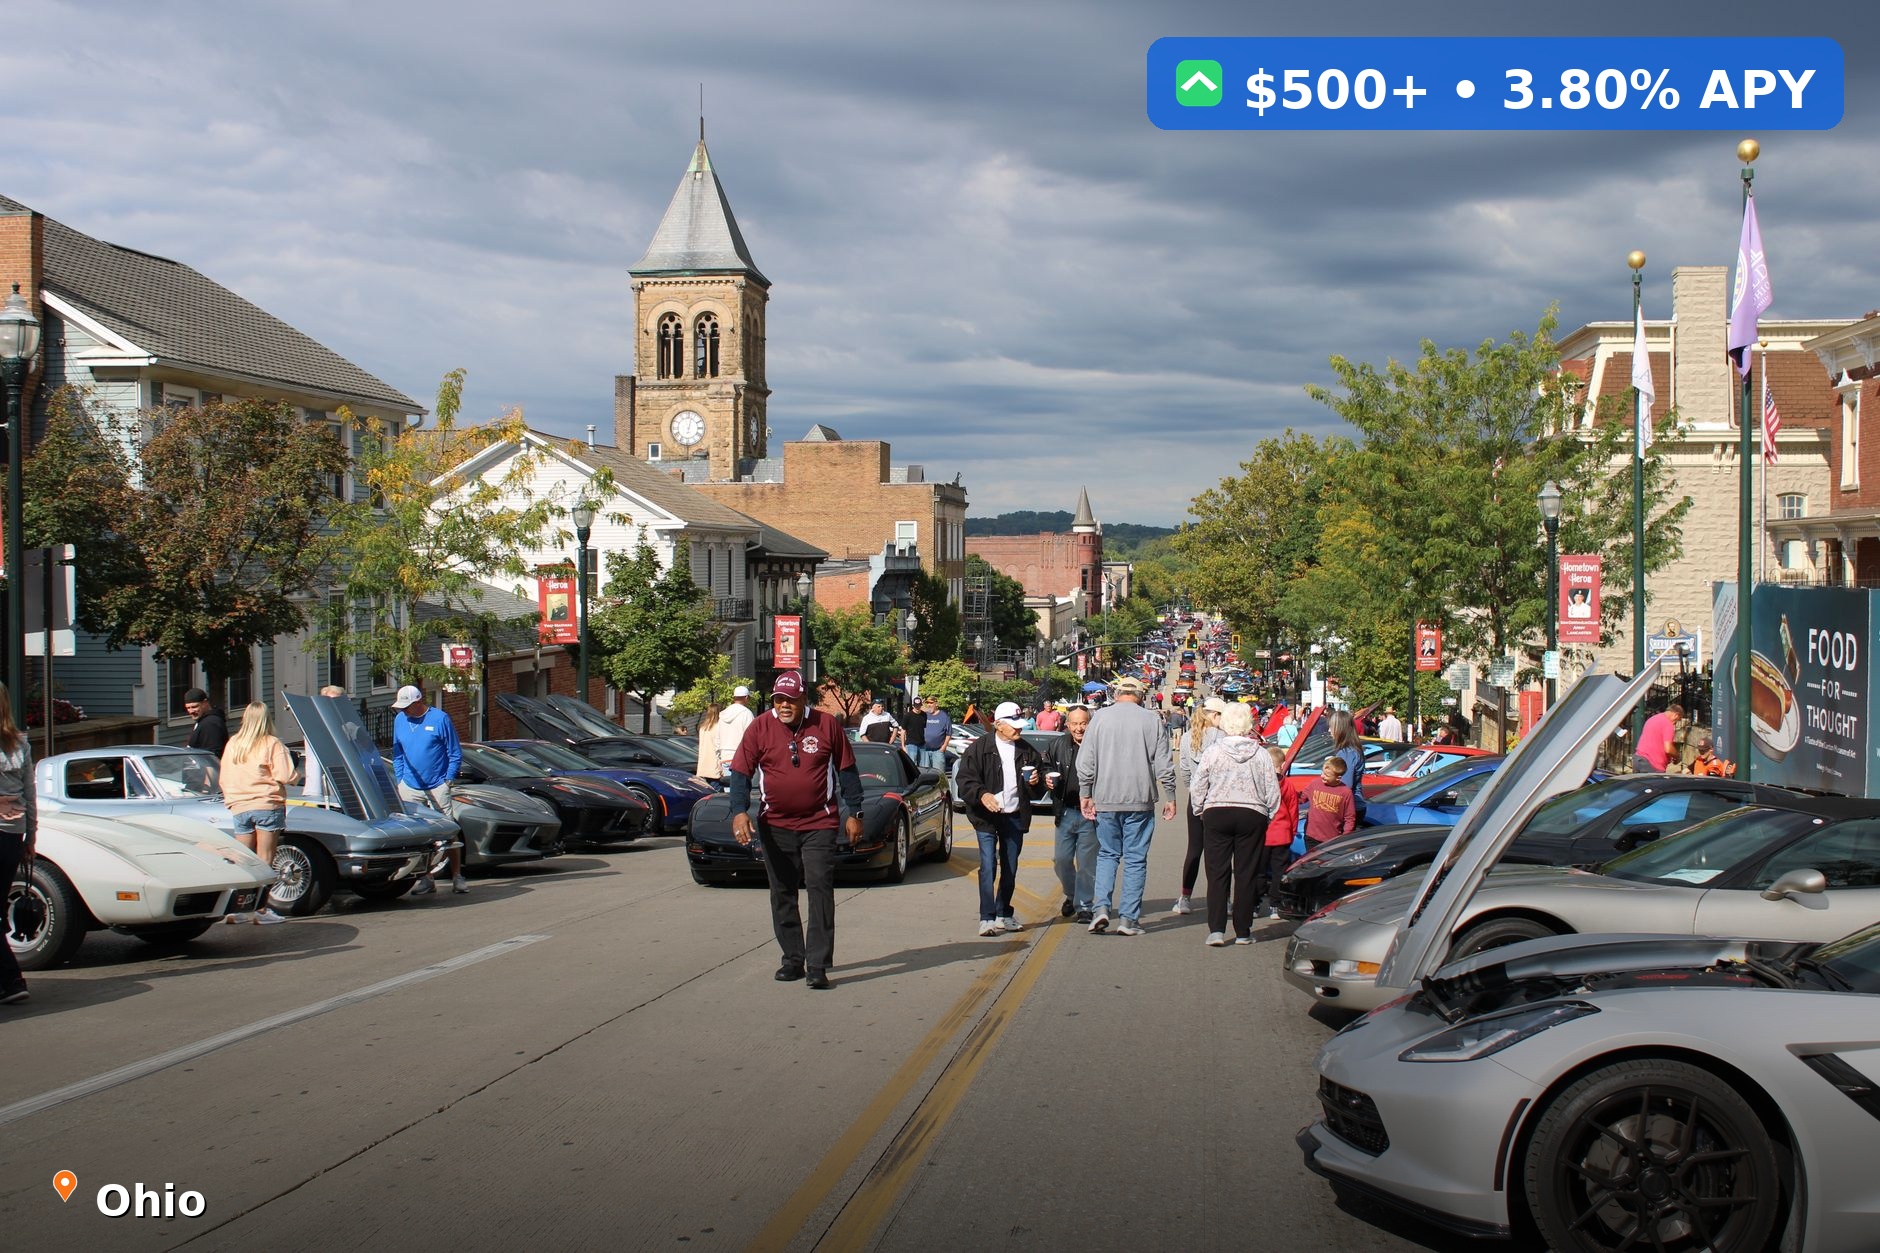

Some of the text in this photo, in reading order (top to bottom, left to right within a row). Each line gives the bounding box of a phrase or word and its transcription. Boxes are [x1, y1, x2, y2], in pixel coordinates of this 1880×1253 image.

[1560, 562, 1599, 575] Hometown
[1808, 628, 1857, 671] FOOD
[1820, 678, 1840, 701] FOR
[1806, 704, 1857, 740] THOUGHT
